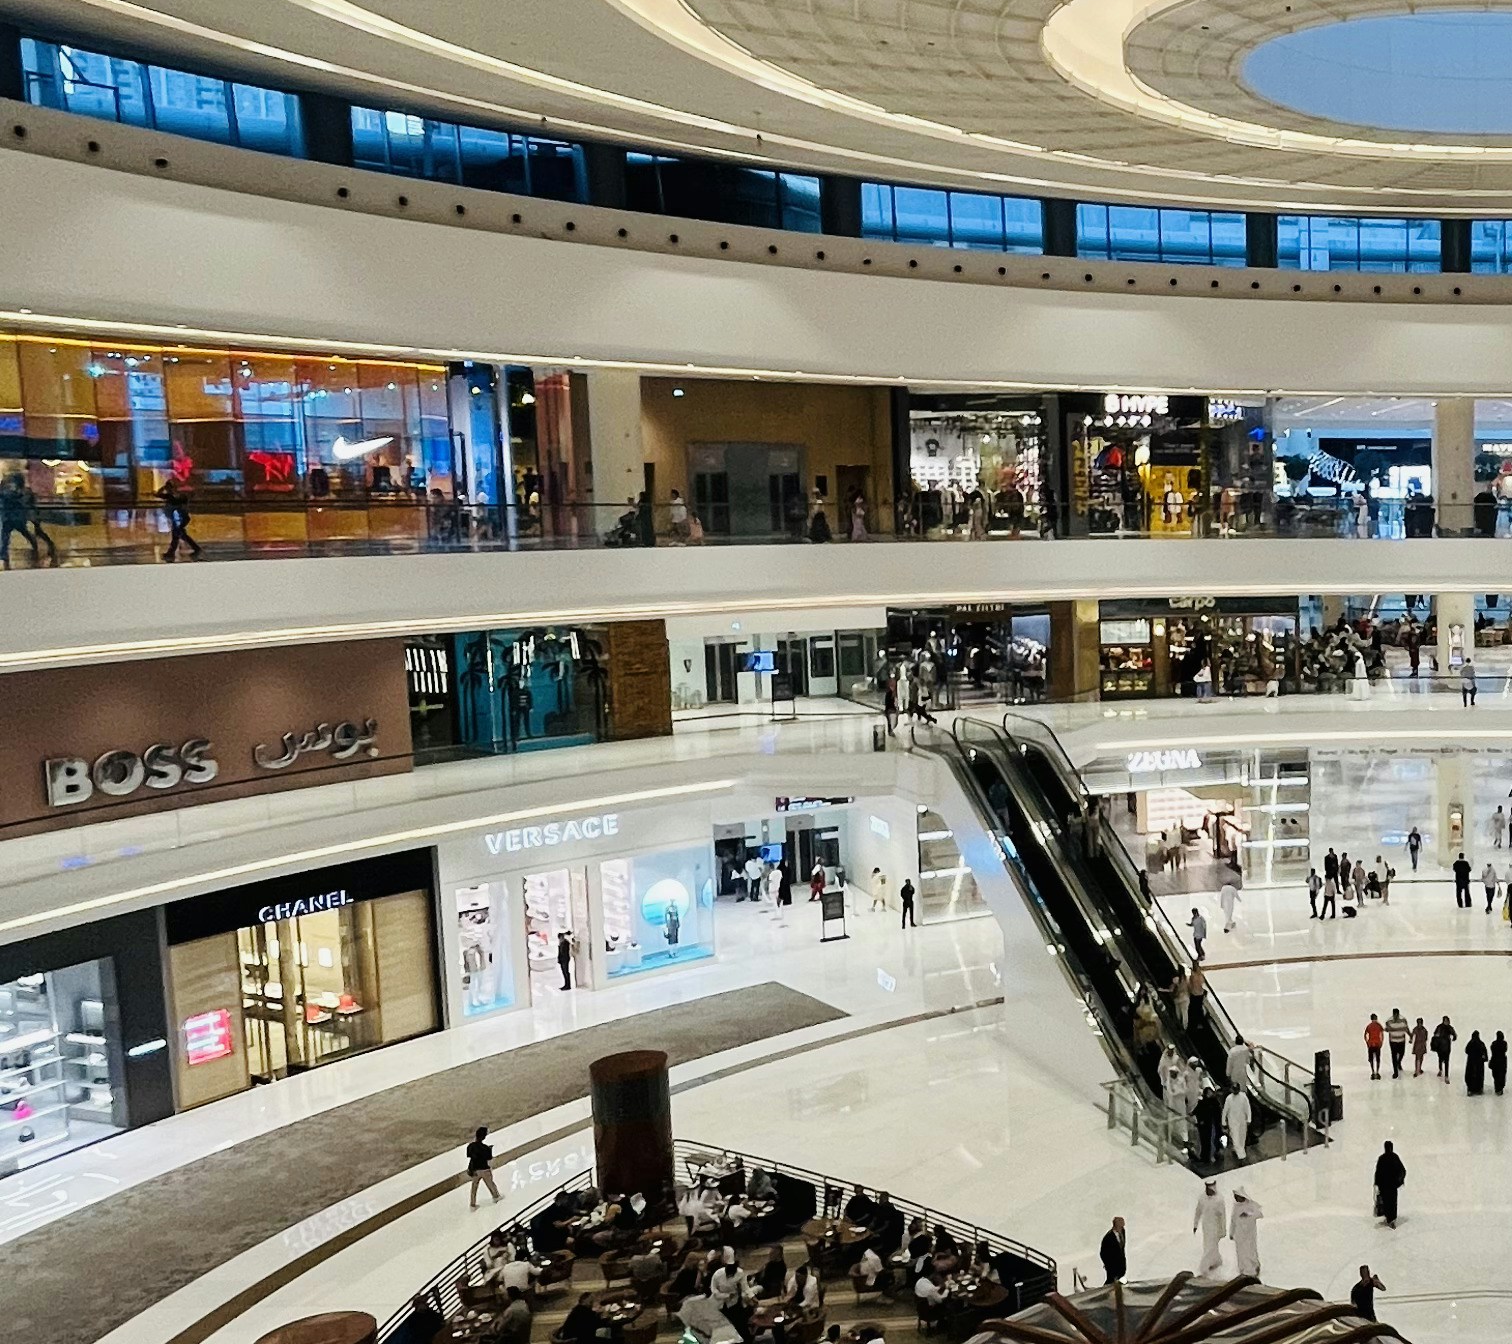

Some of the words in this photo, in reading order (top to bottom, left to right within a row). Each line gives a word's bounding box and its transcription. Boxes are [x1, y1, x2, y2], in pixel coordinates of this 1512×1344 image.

[46, 739, 219, 806] BOSS
[1127, 749, 1202, 772] ZEGNA
[485, 813, 620, 855] VERSACE
[258, 889, 354, 923] CHANEL
